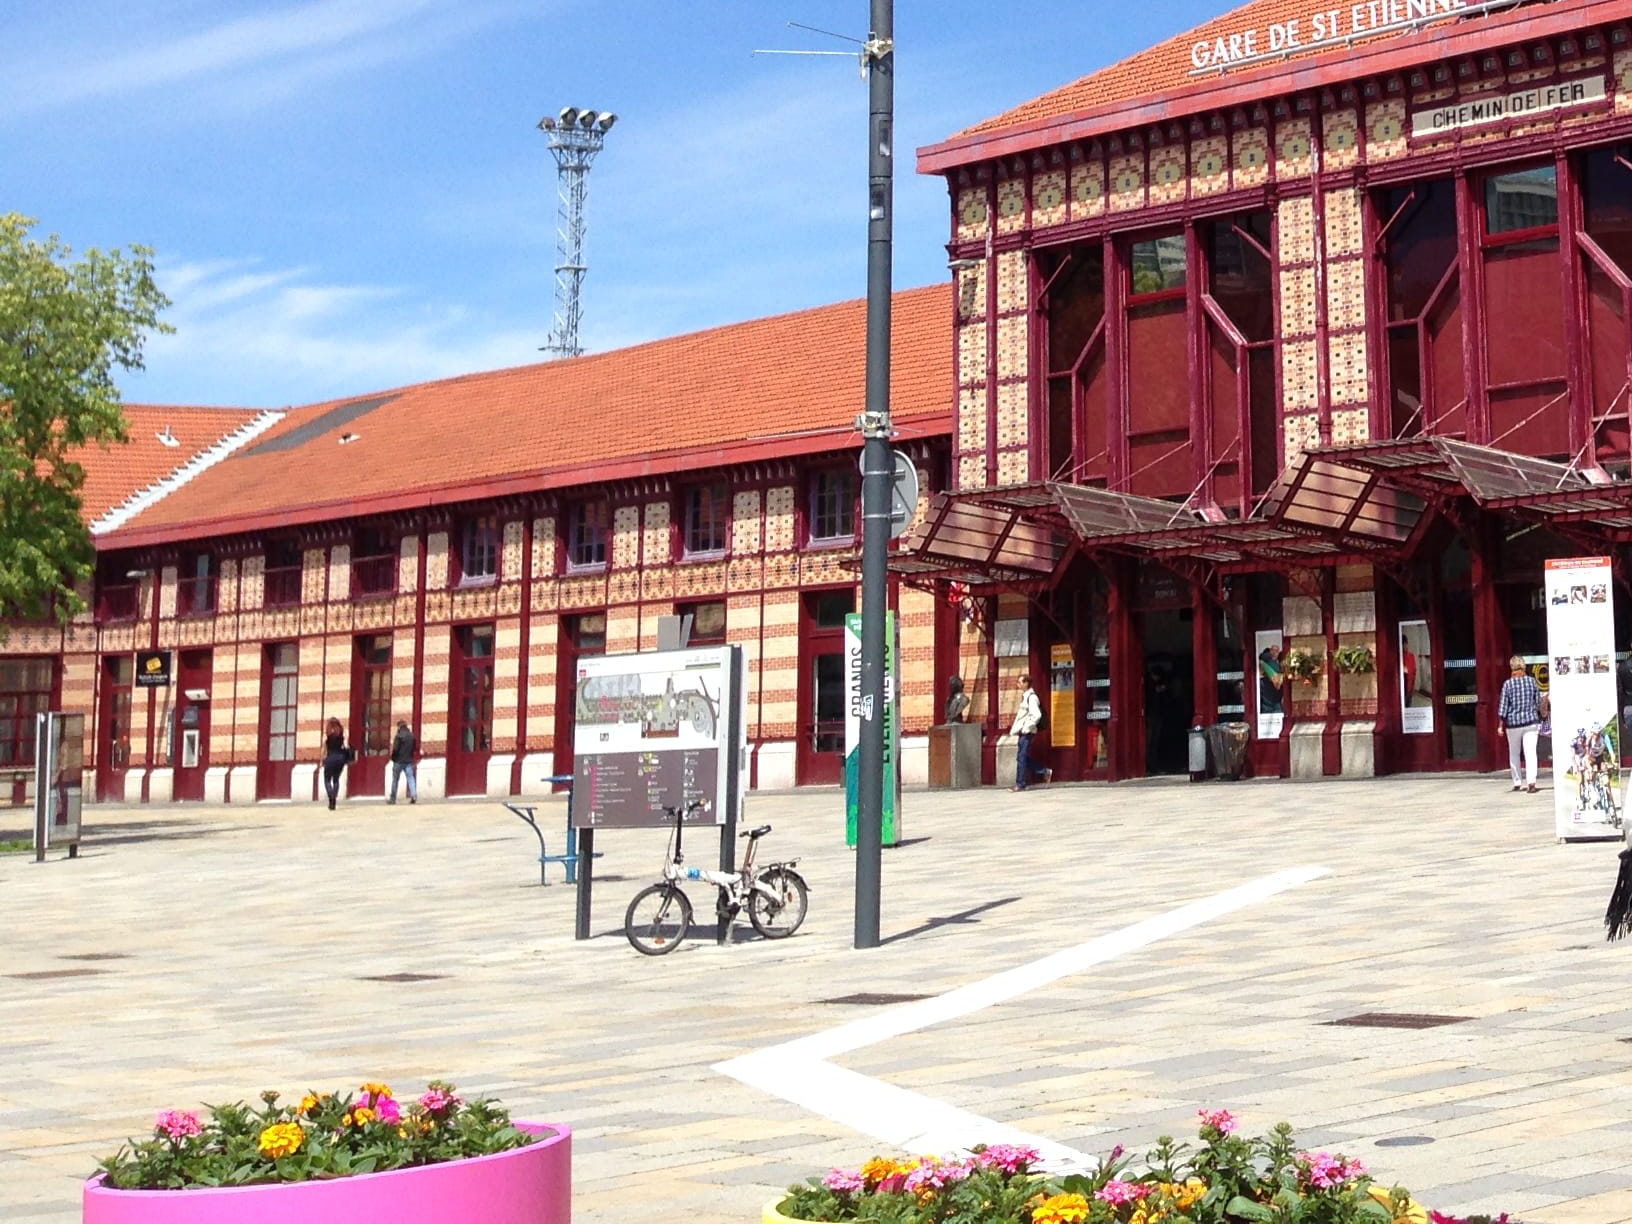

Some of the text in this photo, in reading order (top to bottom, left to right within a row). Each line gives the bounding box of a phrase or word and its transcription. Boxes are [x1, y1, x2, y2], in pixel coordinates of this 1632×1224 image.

[1191, 29, 1258, 68] GARE
[1269, 19, 1301, 51] DE
[1312, 9, 1341, 42] ST
[1433, 83, 1585, 129] CHEMIN DE FER
